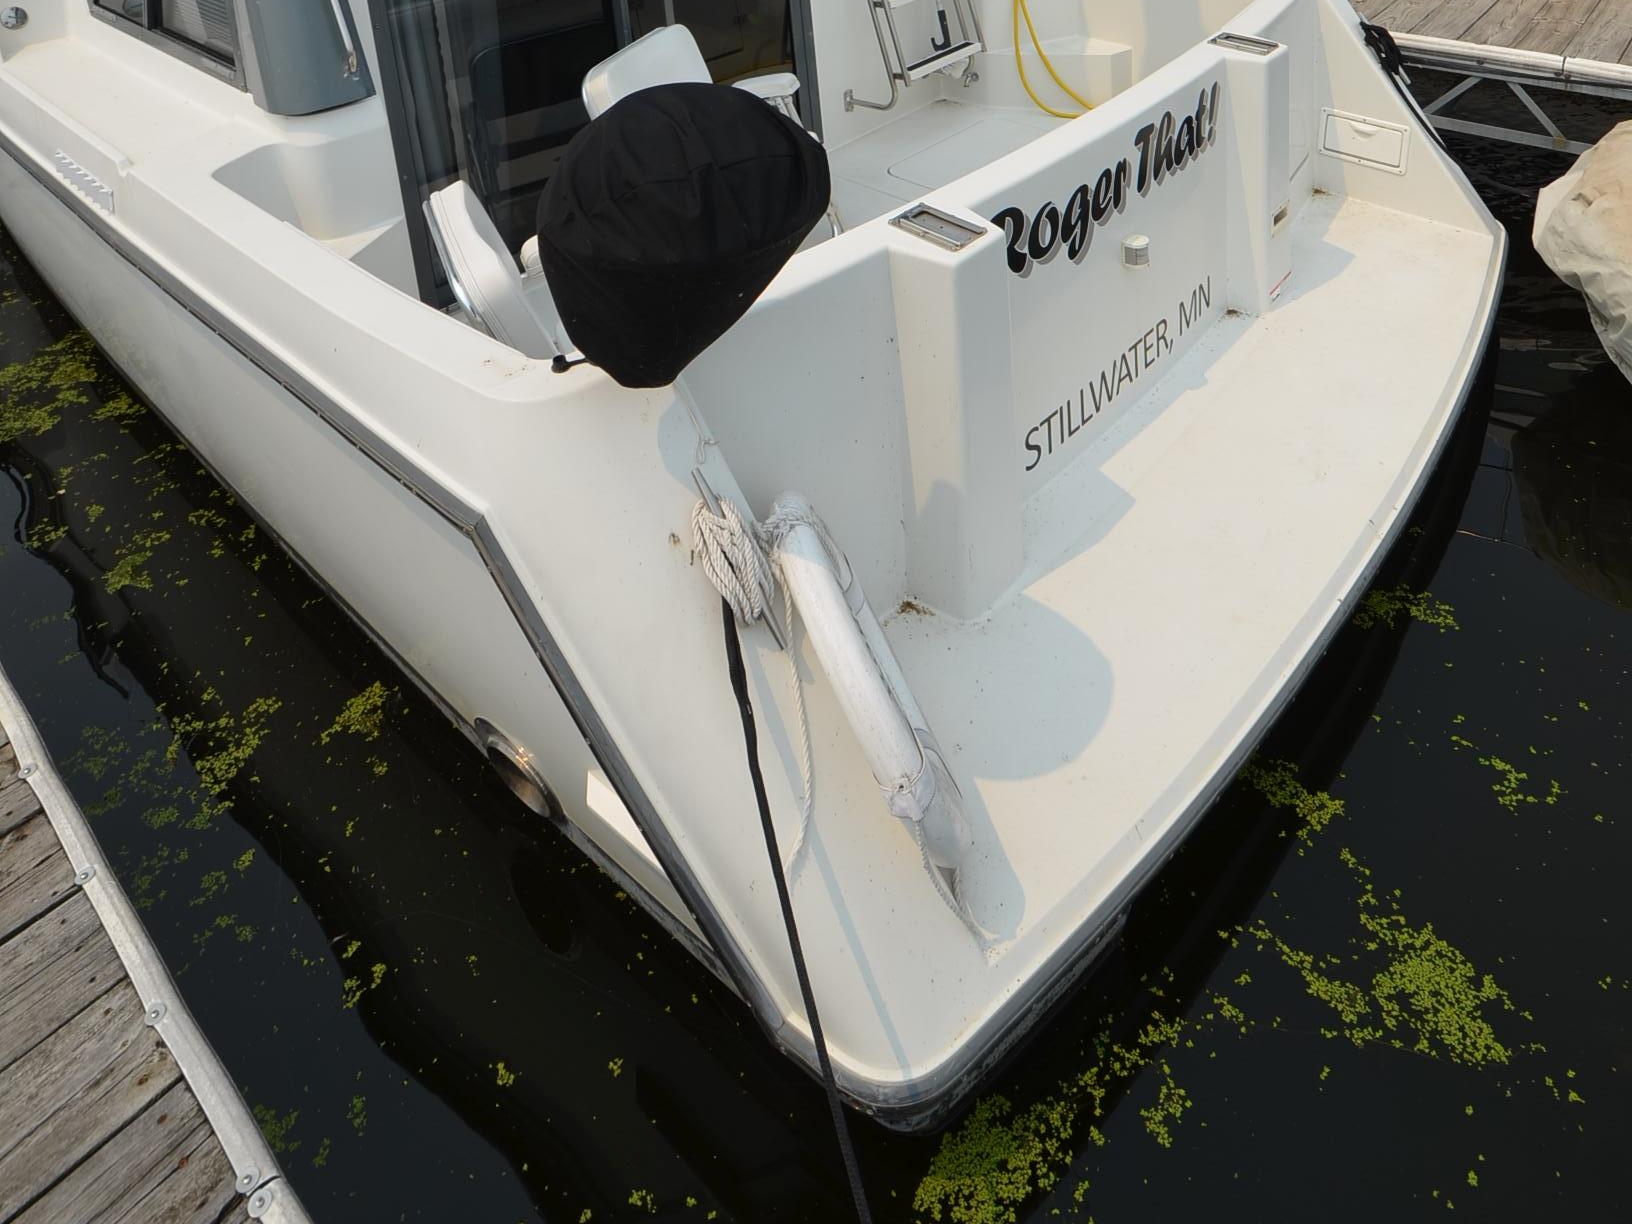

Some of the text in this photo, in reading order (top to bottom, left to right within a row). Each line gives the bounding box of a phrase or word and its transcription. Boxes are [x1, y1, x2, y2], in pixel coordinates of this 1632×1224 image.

[990, 80, 1221, 279] Roger That!
[1024, 275, 1211, 472] STILLWATER, MN
